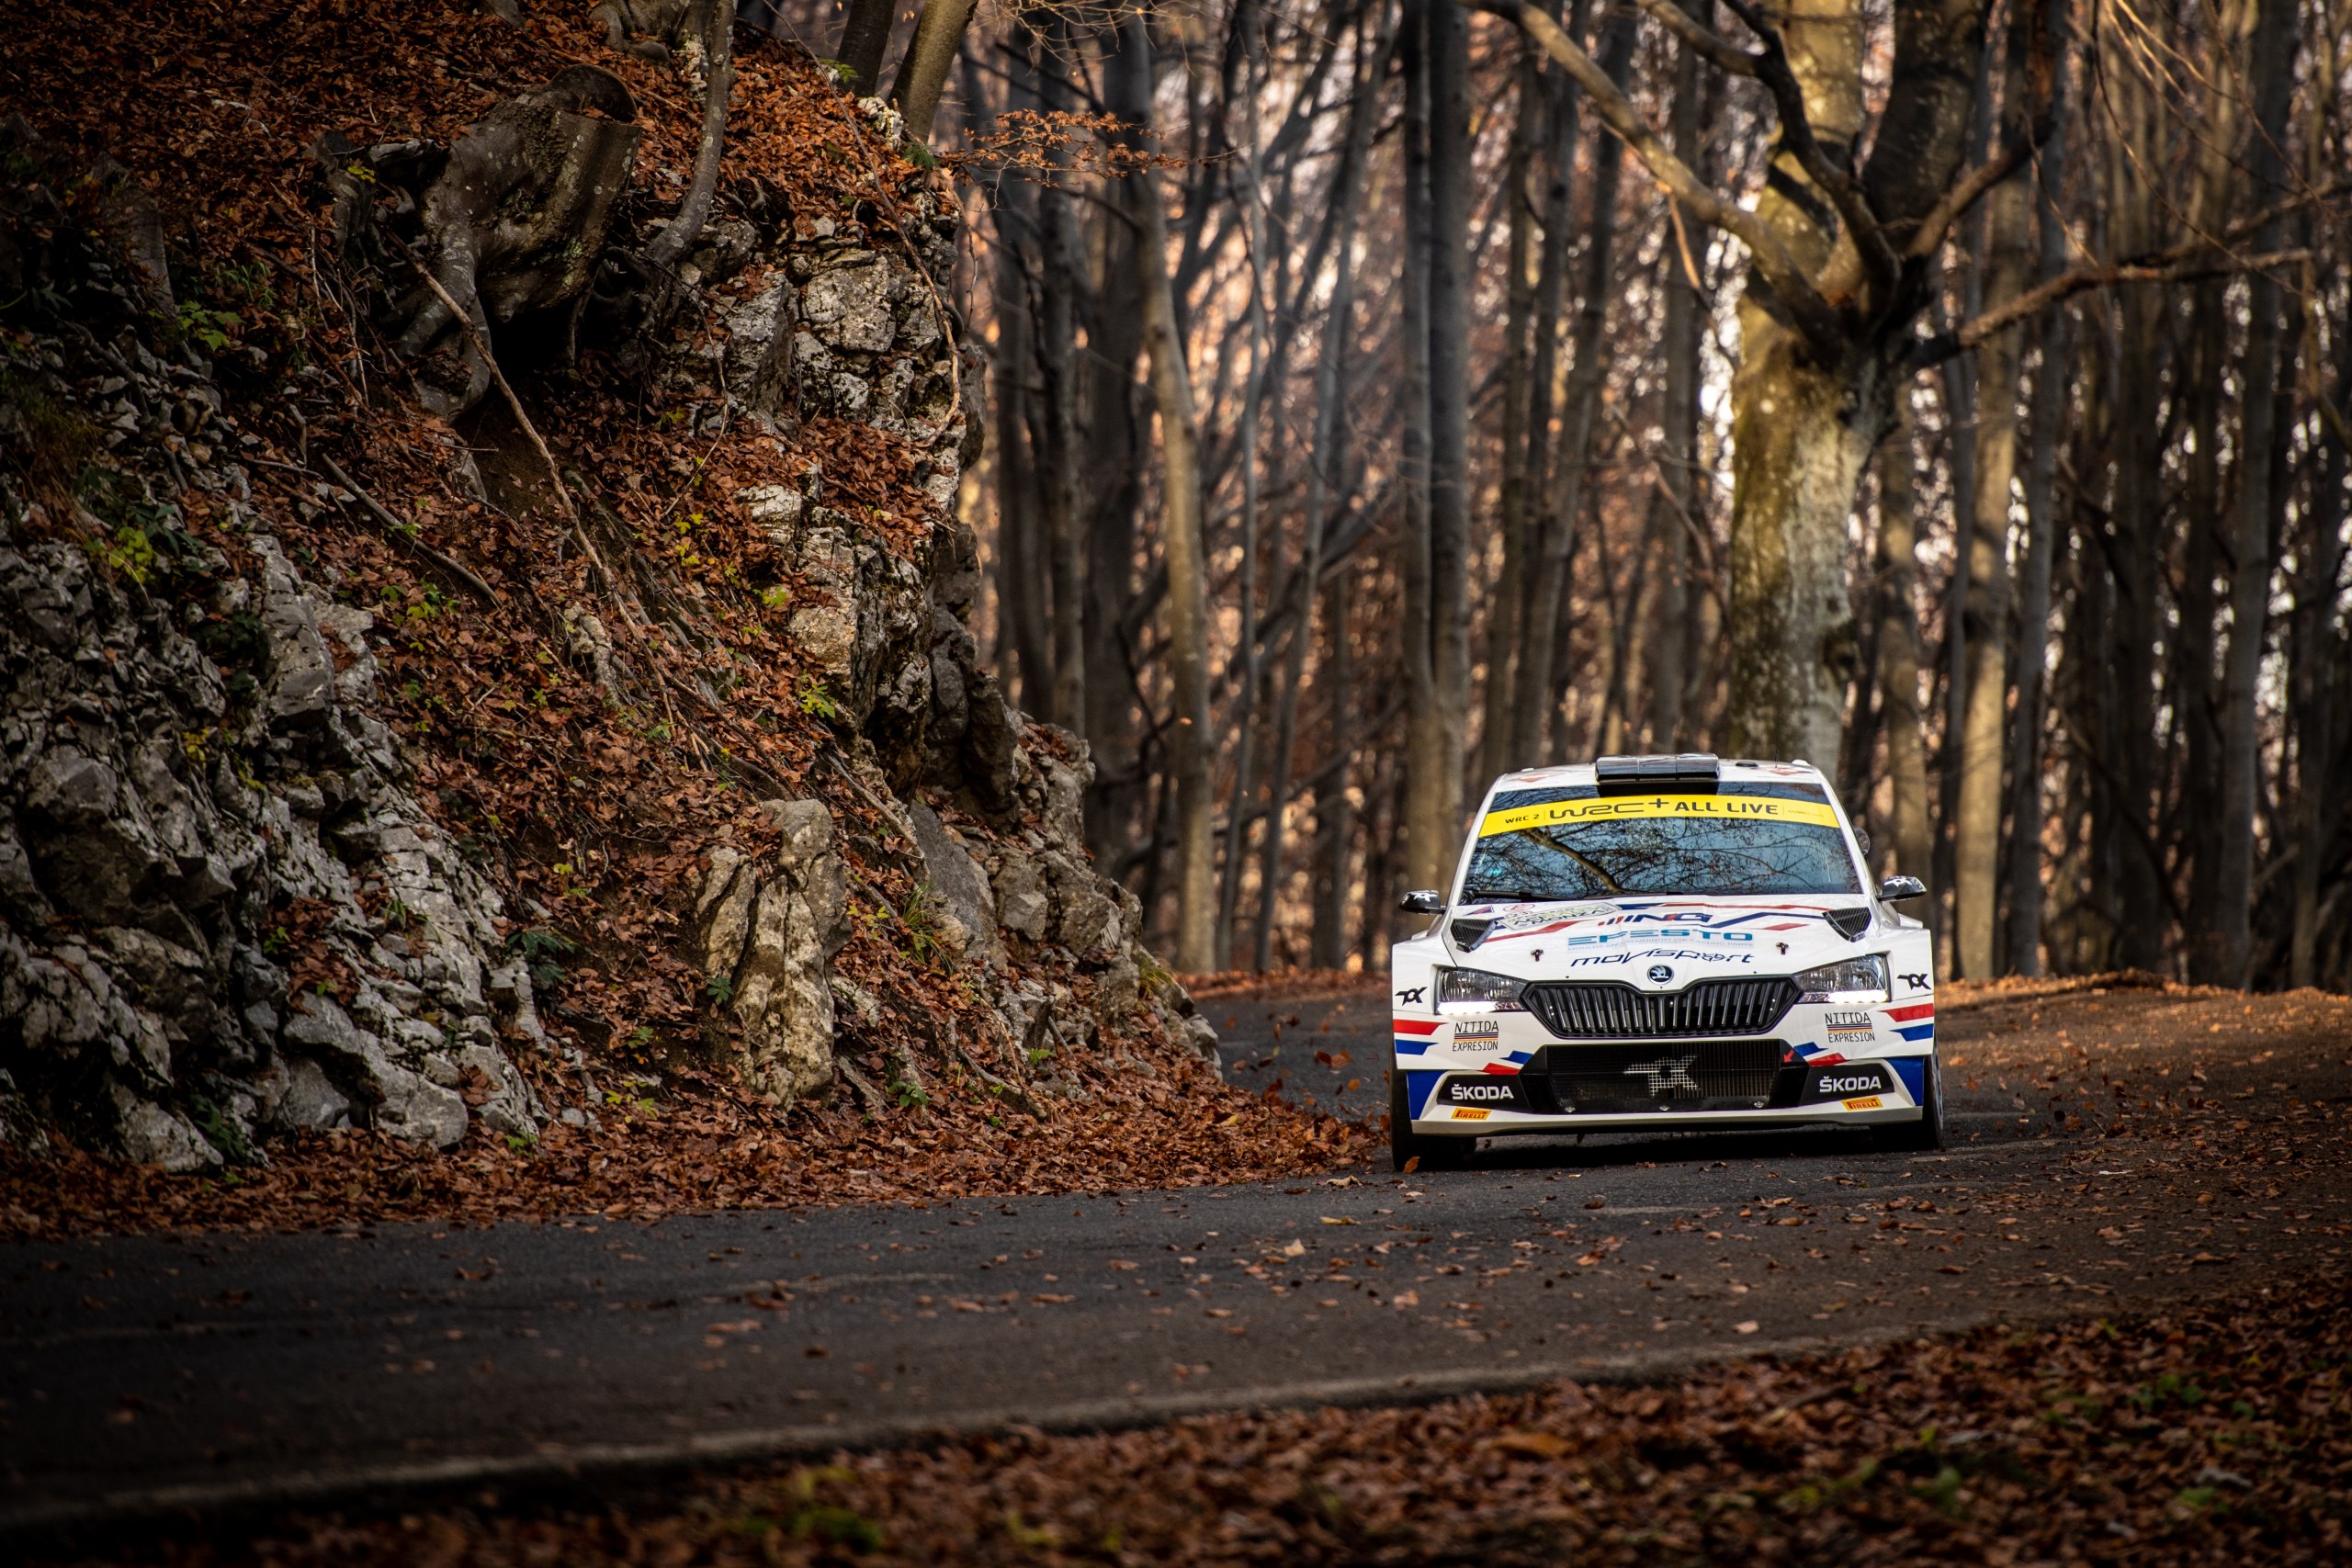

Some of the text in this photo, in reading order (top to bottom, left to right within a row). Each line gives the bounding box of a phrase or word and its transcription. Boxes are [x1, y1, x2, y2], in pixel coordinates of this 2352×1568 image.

[1674, 801, 1719, 812] ALL
[1727, 802, 1779, 815] LIVE
[1505, 815, 1529, 824] WRC
[1532, 908, 1607, 925] MONZA
[1825, 1012, 1871, 1024] NITIDA
[1454, 1021, 1499, 1033] NITIDA
[1827, 1032, 1876, 1043] EXPRESION
[1452, 1041, 1498, 1052] EXPRESION
[1819, 1076, 1882, 1093] ŠKODA
[1451, 1084, 1514, 1100] ŠKODA
[1846, 1099, 1880, 1110] PIRELLI
[1454, 1109, 1487, 1120] PIRELLI
